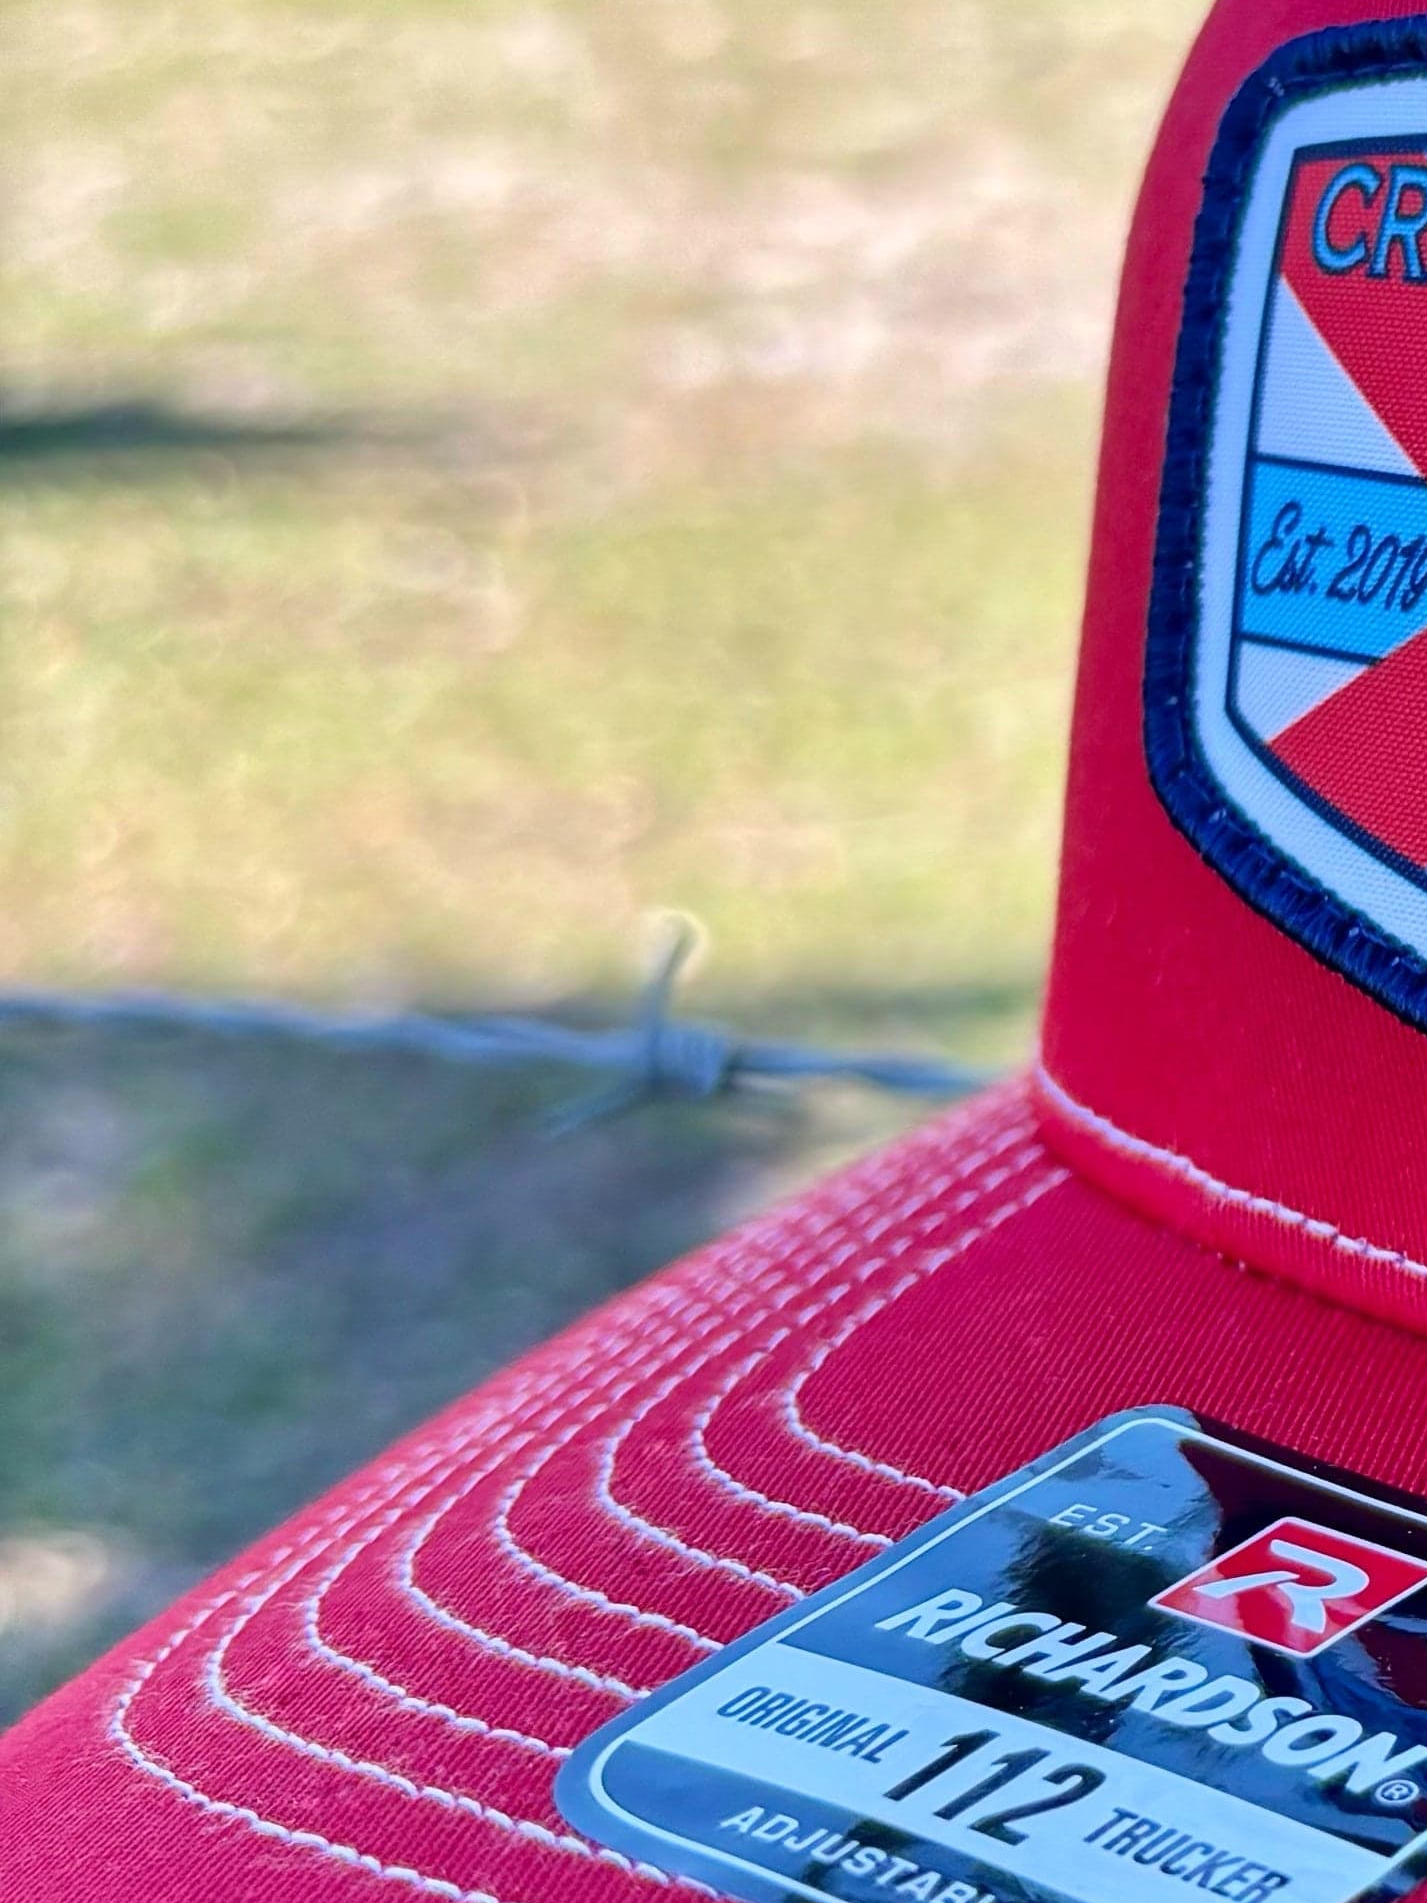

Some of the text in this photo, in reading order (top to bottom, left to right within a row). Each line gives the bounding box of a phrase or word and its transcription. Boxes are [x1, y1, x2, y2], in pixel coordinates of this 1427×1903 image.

[1251, 500, 1334, 595] Est.
[1048, 1503, 1168, 1552] EST.
[715, 1685, 910, 1764] ORIGINAL
[884, 1729, 1107, 1846] 112
